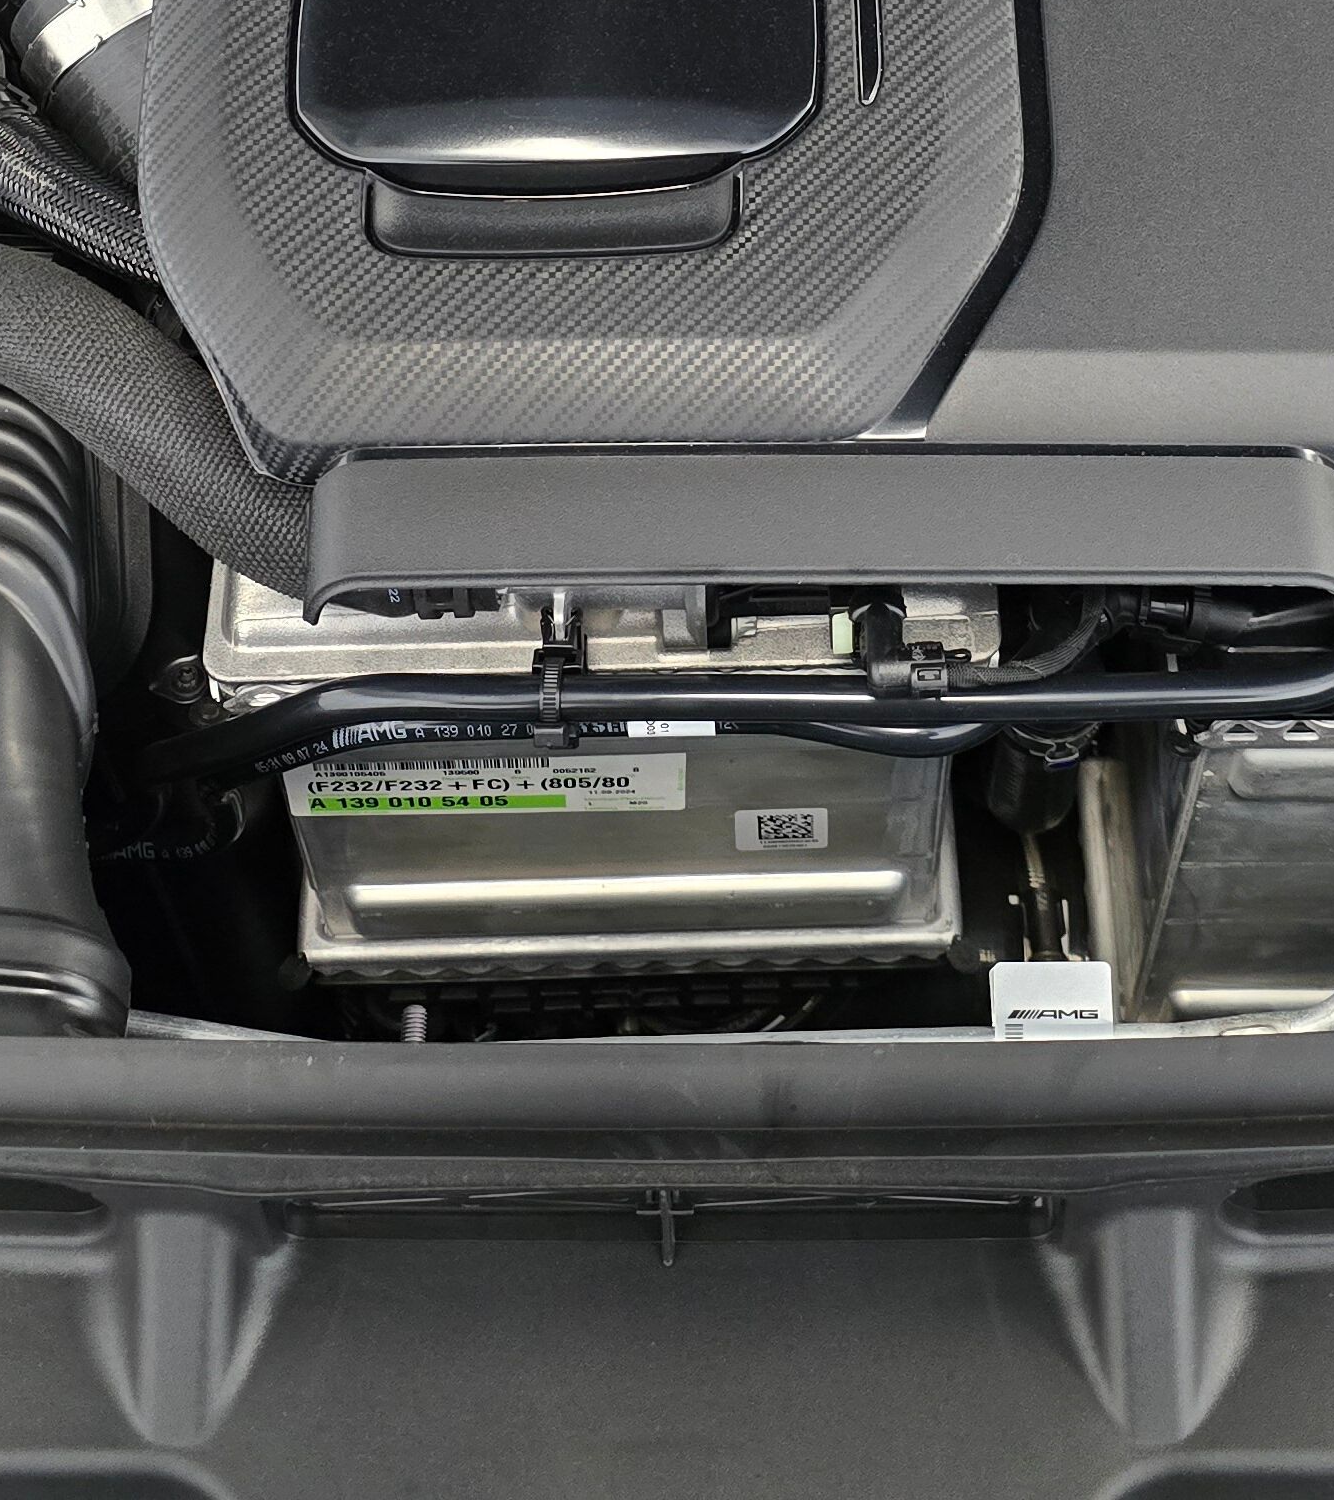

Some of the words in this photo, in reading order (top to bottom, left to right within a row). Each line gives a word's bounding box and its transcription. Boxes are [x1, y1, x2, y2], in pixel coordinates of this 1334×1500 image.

[388, 588, 400, 603] 22
[415, 728, 425, 739] A
[434, 724, 459, 738] 139
[467, 724, 492, 737] 010
[501, 724, 517, 736] 27
[307, 780, 443, 794] (F232/F232
[448, 782, 467, 791] +
[472, 779, 511, 792] FC)
[517, 778, 535, 789] +
[540, 776, 630, 791] (805/80
[310, 798, 327, 809] A
[337, 797, 379, 809] 139
[388, 797, 431, 808] 010
[442, 796, 469, 807] 54
[479, 795, 508, 806] 05
[1037, 1010, 1098, 1019] AMG
